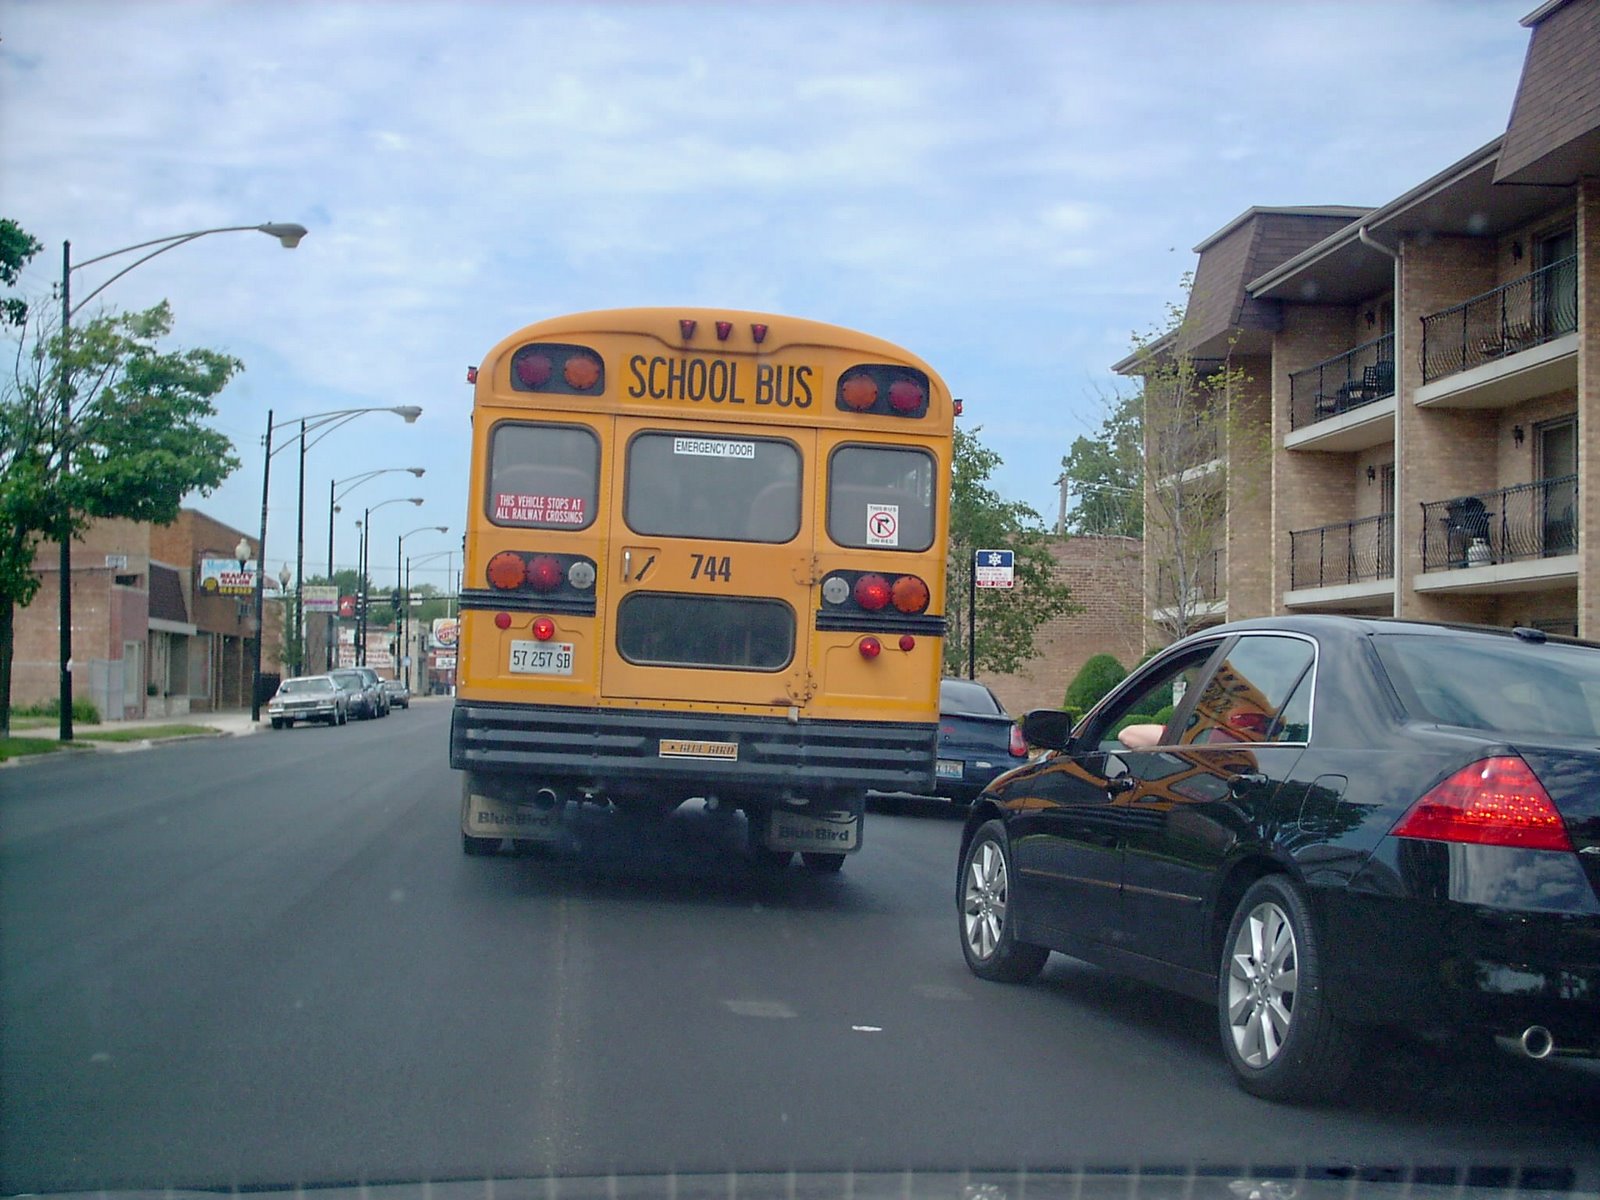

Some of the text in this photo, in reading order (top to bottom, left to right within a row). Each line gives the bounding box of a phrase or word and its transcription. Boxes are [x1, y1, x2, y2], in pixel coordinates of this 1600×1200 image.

[628, 354, 813, 409] SCHOOL BUS
[675, 440, 753, 456] EMERGENCY DOOR
[500, 494, 582, 511] THIS VEHICLE STOPS AT
[495, 507, 584, 524] ALL RAILWAY CROSSINGS
[690, 553, 732, 582] 744
[513, 649, 571, 669] 57 257 SB
[708, 744, 735, 755] BIRD
